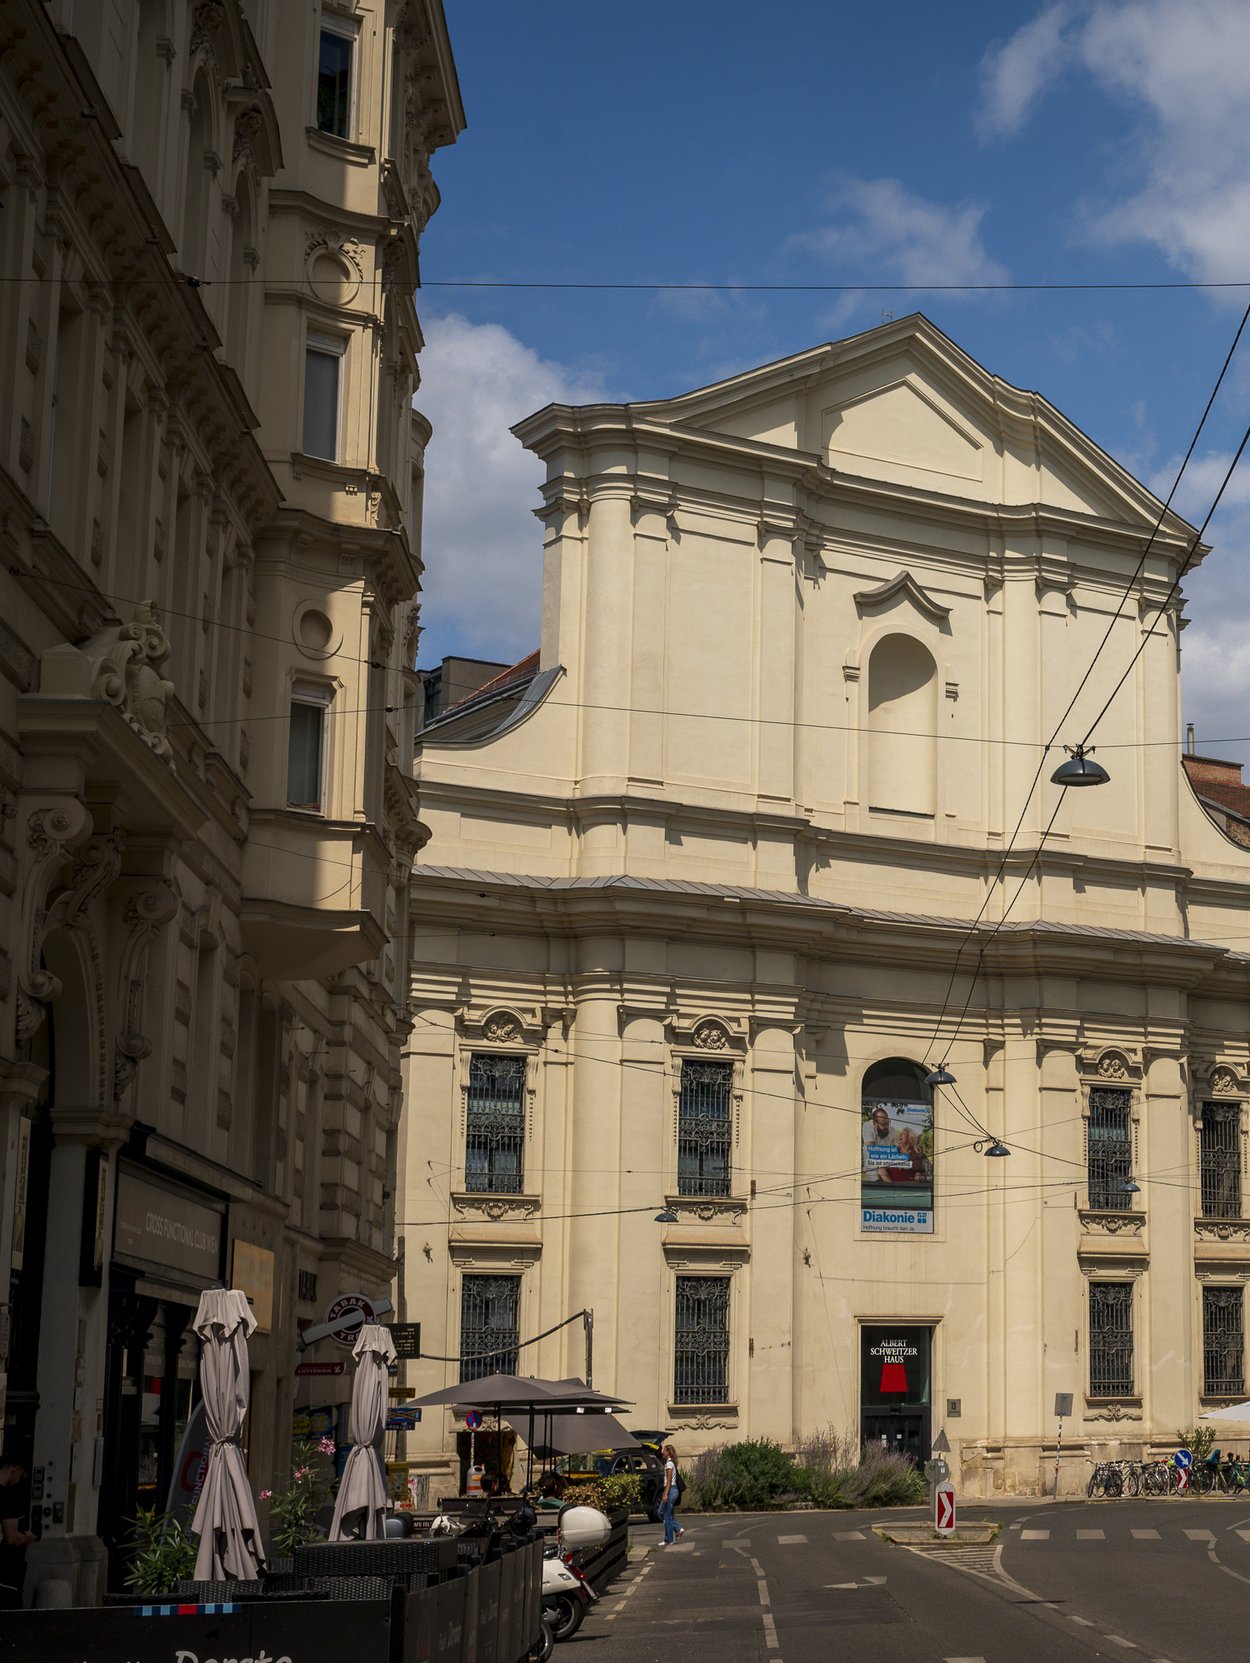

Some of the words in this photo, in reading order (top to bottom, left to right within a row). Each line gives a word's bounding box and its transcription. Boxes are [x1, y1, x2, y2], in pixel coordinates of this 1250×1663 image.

[863, 1210, 915, 1224] Diakonie
[145, 1212, 163, 1236] CROSS
[163, 1218, 194, 1247] FUNCTIONAL
[194, 1229, 207, 1251] CLUB
[207, 1234, 218, 1255] WIEN
[329, 1297, 366, 1319] TABAK
[880, 1339, 908, 1347] ALBERT
[870, 1347, 918, 1356] SCHWEITZER
[884, 1355, 904, 1364] HAUS
